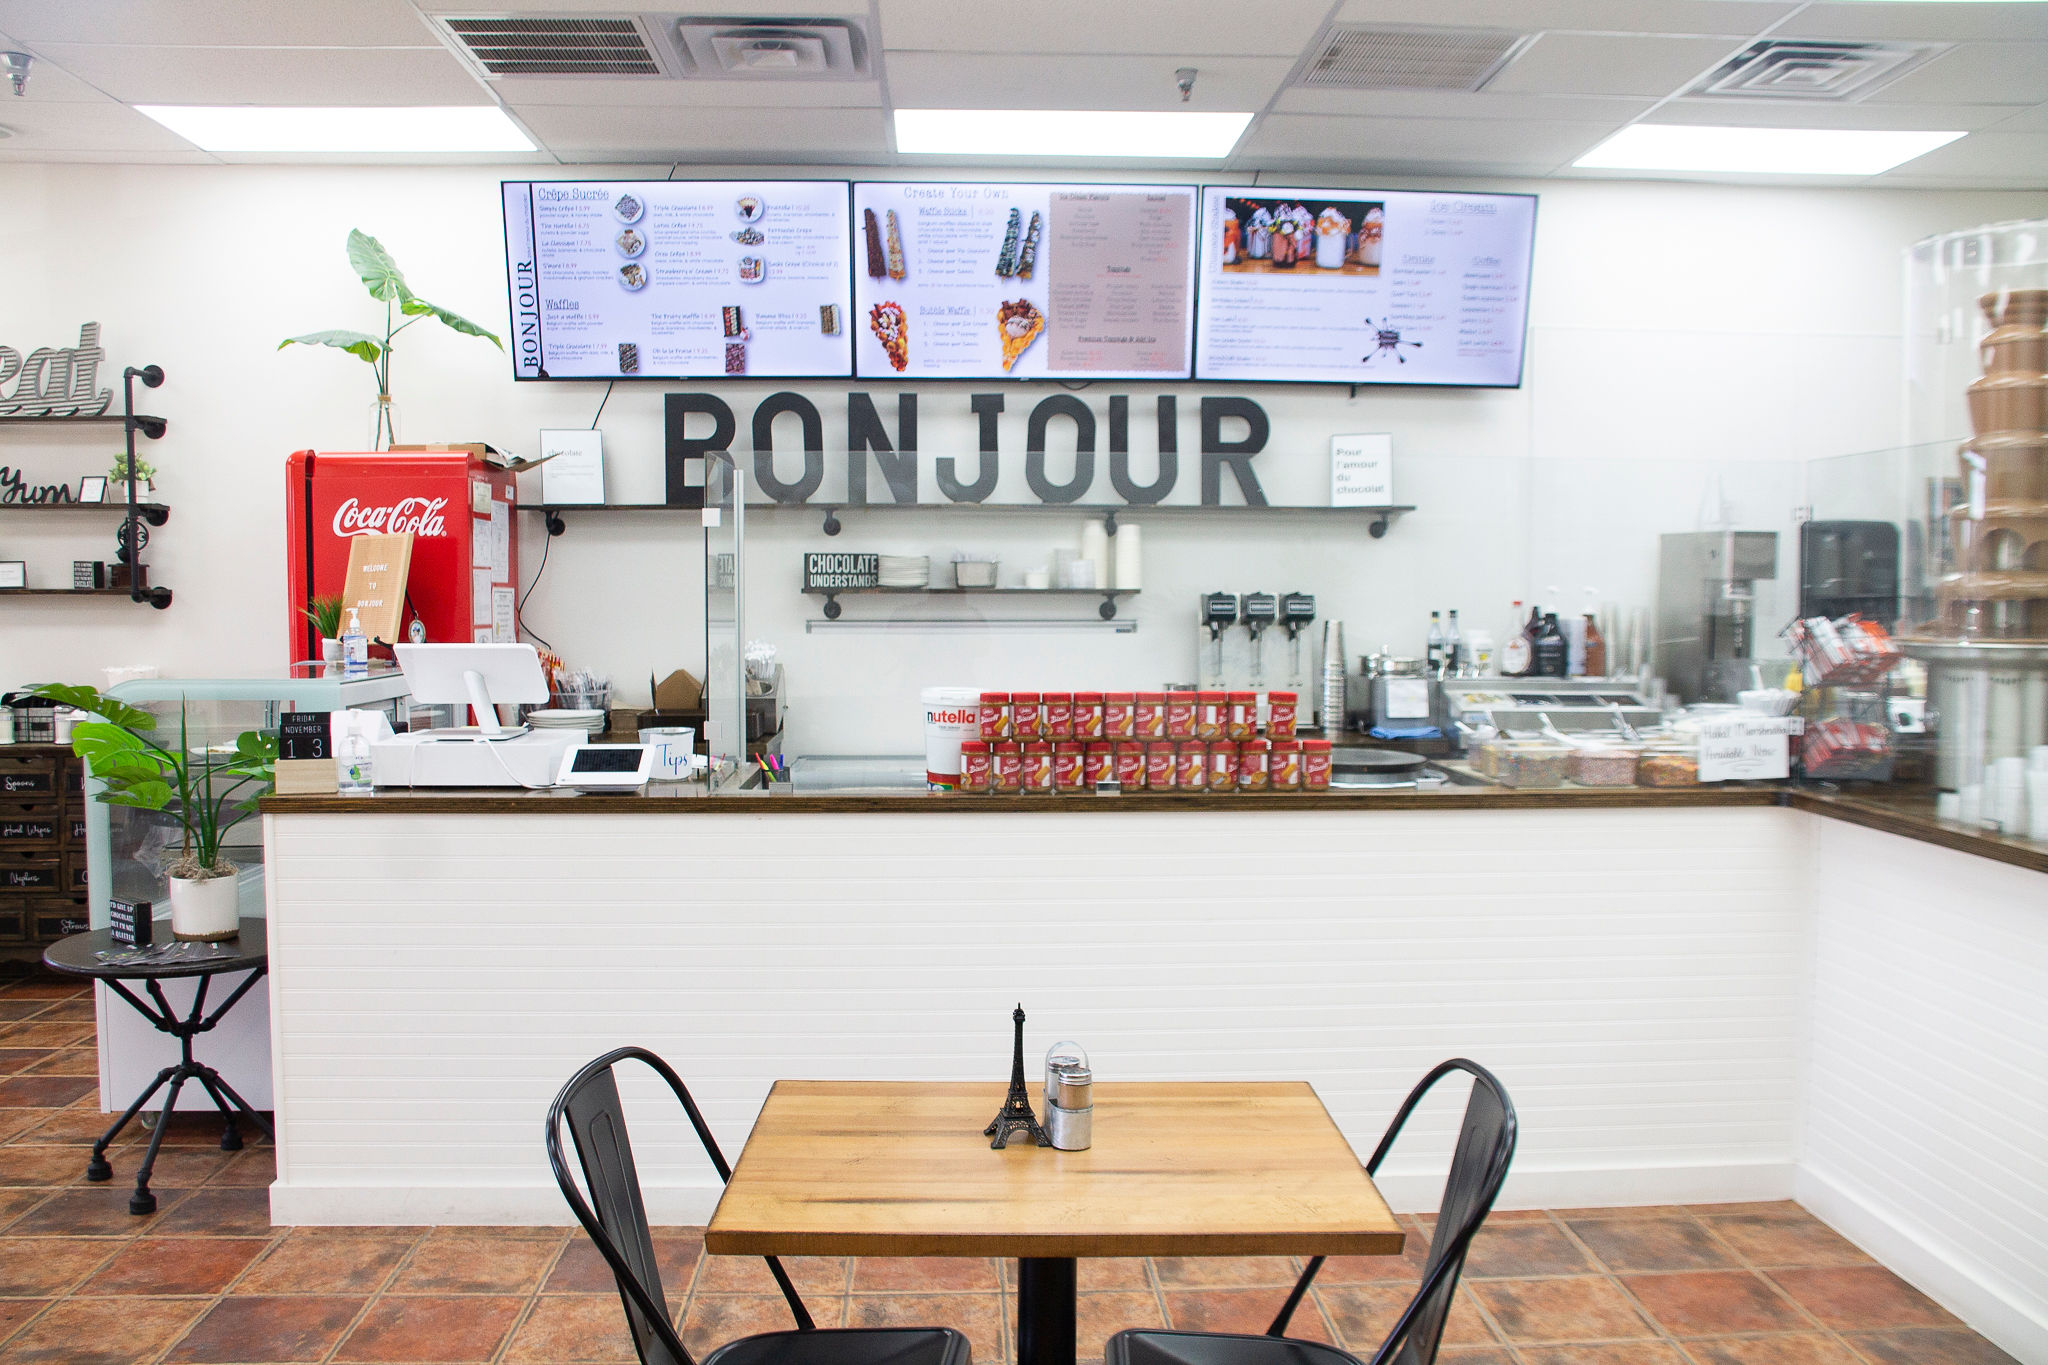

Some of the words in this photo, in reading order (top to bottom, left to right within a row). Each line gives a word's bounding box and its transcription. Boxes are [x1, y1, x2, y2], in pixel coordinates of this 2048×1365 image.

[538, 187, 569, 202] Crêpe
[572, 187, 609, 200] Sucrée
[904, 187, 944, 199] Create
[951, 187, 977, 199] Your
[545, 298, 580, 310] Waffles
[517, 260, 539, 368] BONJOUR
[664, 391, 1271, 507] BONJOUR
[1336, 448, 1362, 456] Pour
[333, 497, 449, 537] Coca-Cola
[363, 563, 389, 573] WELCOME
[809, 554, 877, 574] CHOCOLATE
[368, 582, 377, 591] TO
[810, 574, 878, 588] UNDERSTANDS
[357, 600, 383, 609] BONJOUR
[292, 714, 316, 723] FRIDAY
[927, 709, 976, 724] nutella
[285, 725, 322, 734] NOVEMBER
[656, 743, 688, 776] Tips
[5, 776, 36, 792] Spoons
[2, 824, 24, 837] Hand
[27, 824, 52, 838] Wipes
[61, 919, 90, 934] Straws
